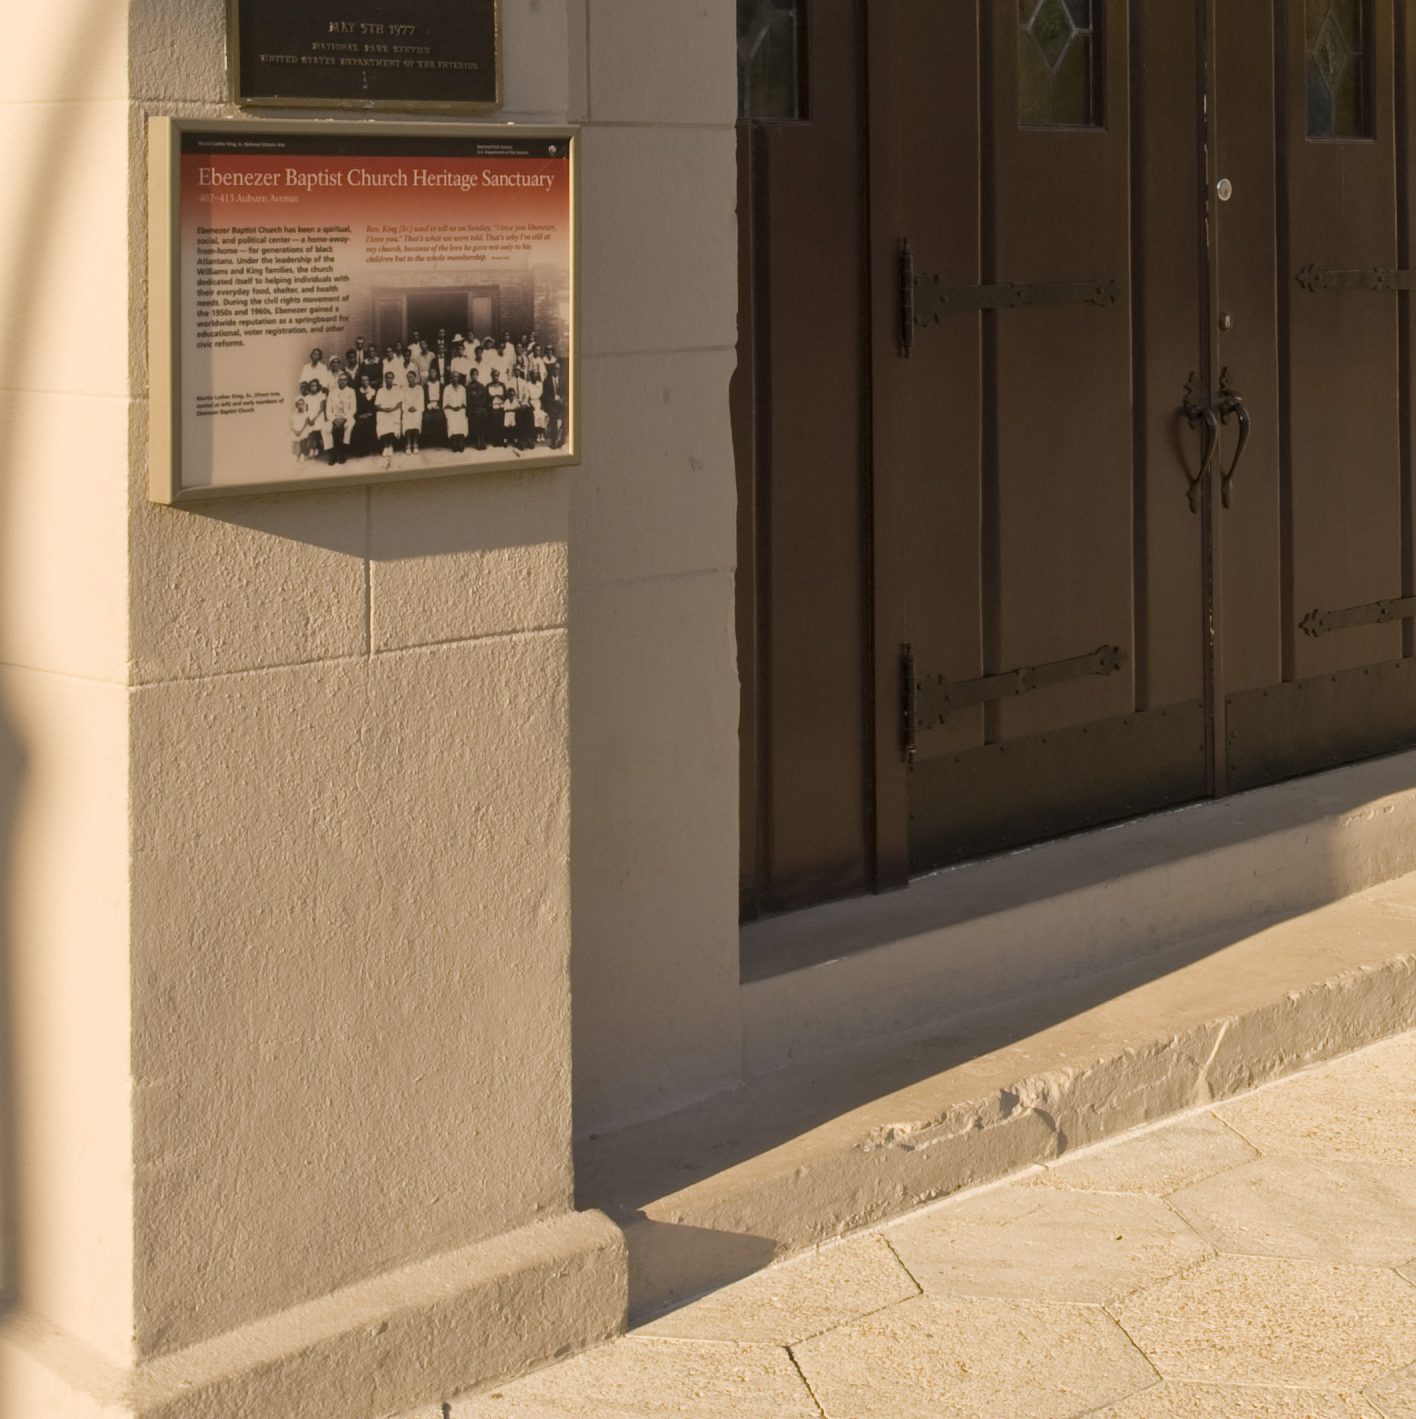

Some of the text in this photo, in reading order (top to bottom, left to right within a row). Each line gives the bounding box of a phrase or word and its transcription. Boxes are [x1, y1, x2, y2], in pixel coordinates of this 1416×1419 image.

[328, 21, 416, 36] MAY 5TH 1977
[199, 167, 555, 192] Ebenezer Baptist Church Heritage Sanctuary
[236, 194, 268, 203] Auburn
[270, 194, 299, 203] Avenue
[232, 226, 256, 234] Baptist
[284, 225, 296, 233] has
[298, 225, 315, 233] been
[323, 225, 352, 234] spiritual,
[197, 237, 219, 245] social,
[238, 236, 267, 245] political
[261, 247, 303, 255] generations
[275, 256, 312, 264] leadership
[246, 267, 263, 276] King
[265, 266, 295, 274] families,
[197, 278, 233, 286] dedicated
[235, 277, 253, 285] itself
[265, 277, 292, 285] helping
[294, 275, 332, 283] individuals
[216, 288, 250, 297] everyday
[252, 287, 271, 295] food,
[273, 286, 299, 294] shelter,
[301, 285, 314, 293] and
[223, 299, 249, 307] During
[280, 296, 300, 305] rights
[342, 294, 350, 302] of
[251, 307, 273, 315] 1960s,
[309, 305, 333, 314] gained
[197, 319, 236, 327] worldwide
[239, 318, 277, 327] reputation
[295, 315, 337, 325] springboard
[339, 314, 349, 322] for
[197, 329, 242, 338] educational,
[265, 327, 308, 336] registration,
[214, 339, 245, 347] reforms.
